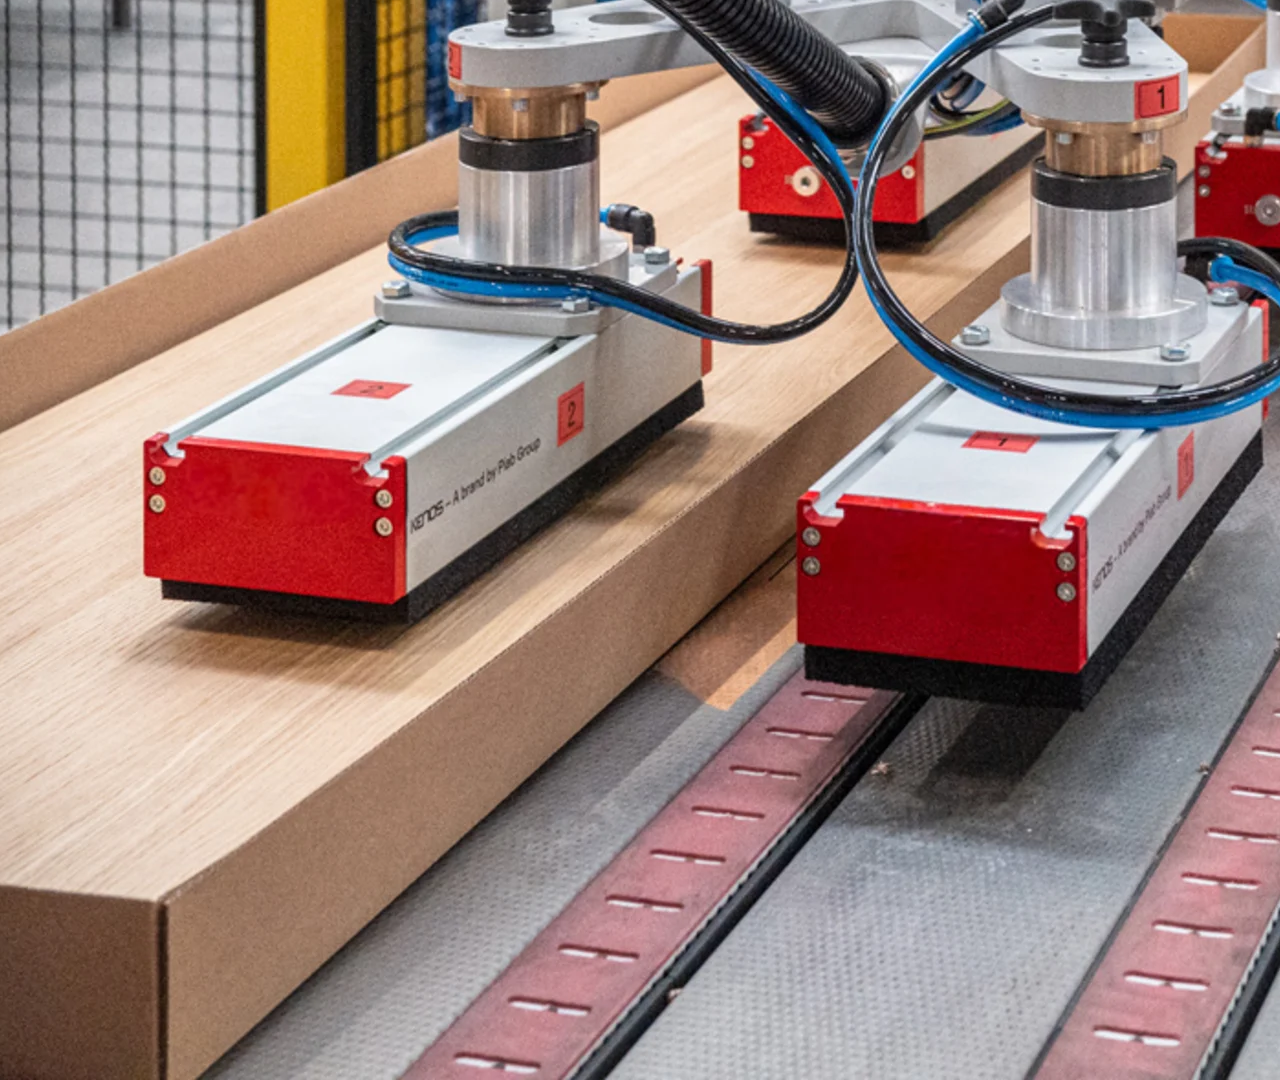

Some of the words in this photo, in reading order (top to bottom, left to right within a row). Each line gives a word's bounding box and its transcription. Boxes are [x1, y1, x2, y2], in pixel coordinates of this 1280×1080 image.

[1157, 84, 1166, 110] 1
[567, 401, 577, 428] 2
[452, 489, 460, 507] A
[461, 471, 485, 500] brand
[486, 467, 497, 483] by
[516, 437, 541, 461] Group
